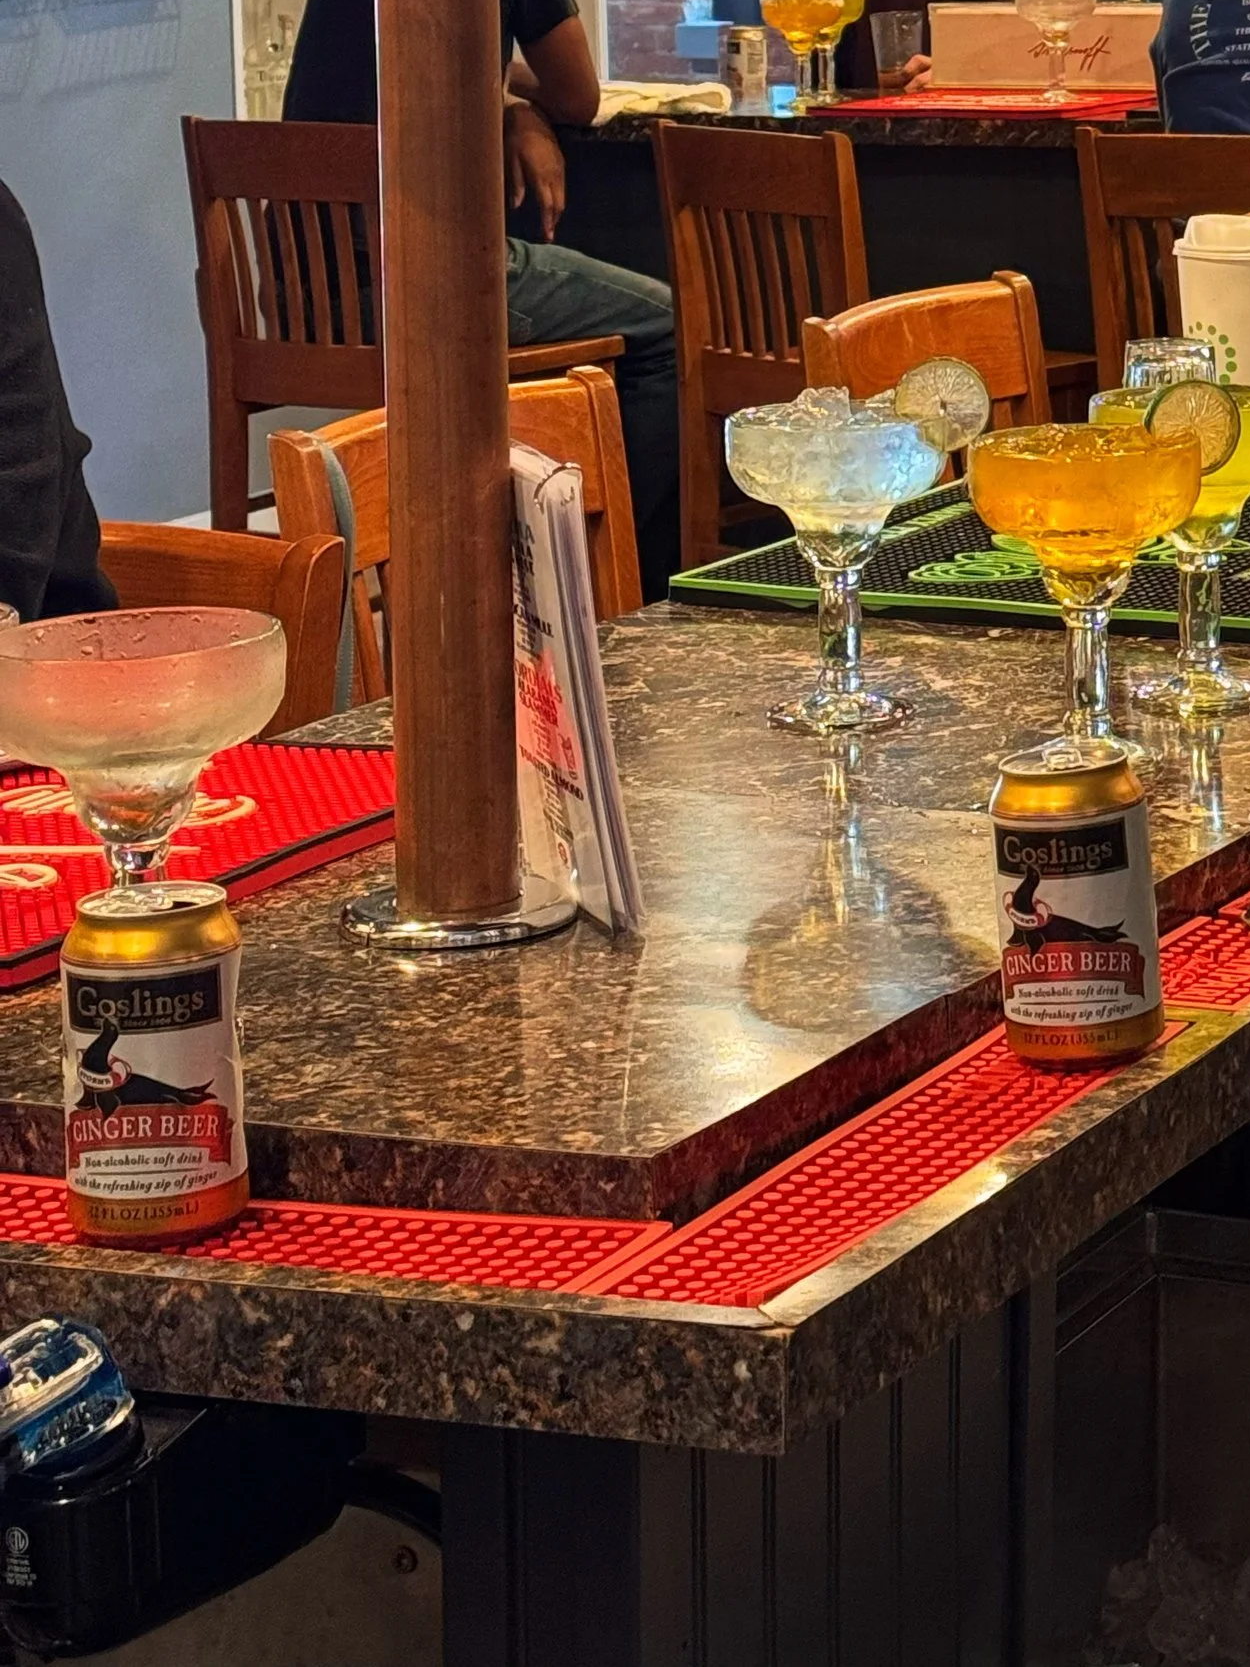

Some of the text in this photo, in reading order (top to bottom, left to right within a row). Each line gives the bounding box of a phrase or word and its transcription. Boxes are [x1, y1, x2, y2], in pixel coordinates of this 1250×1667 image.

[1189, 3, 1212, 60] THE
[514, 659, 563, 704] ORDIALS
[1003, 836, 1113, 869] Goslings
[1006, 951, 1132, 977] GINGER BEER
[76, 986, 204, 1022] Goslings
[1018, 984, 1119, 998] Non-alcoholic soft drink
[1023, 1008, 1033, 1017] the
[1095, 1004, 1107, 1016] of
[1108, 1002, 1133, 1017] ginger
[73, 1114, 219, 1142] GINGER BEER
[84, 1152, 204, 1168] Non-alcoholic soft drink
[88, 1178, 102, 1189] the
[102, 1181, 152, 1194] refreshing
[154, 1182, 171, 1193] zip
[174, 1178, 187, 1190] of
[187, 1171, 218, 1189] ginger
[101, 1206, 117, 1220] FL
[119, 1206, 142, 1221] OZ
[144, 1201, 200, 1220] (355mL)
